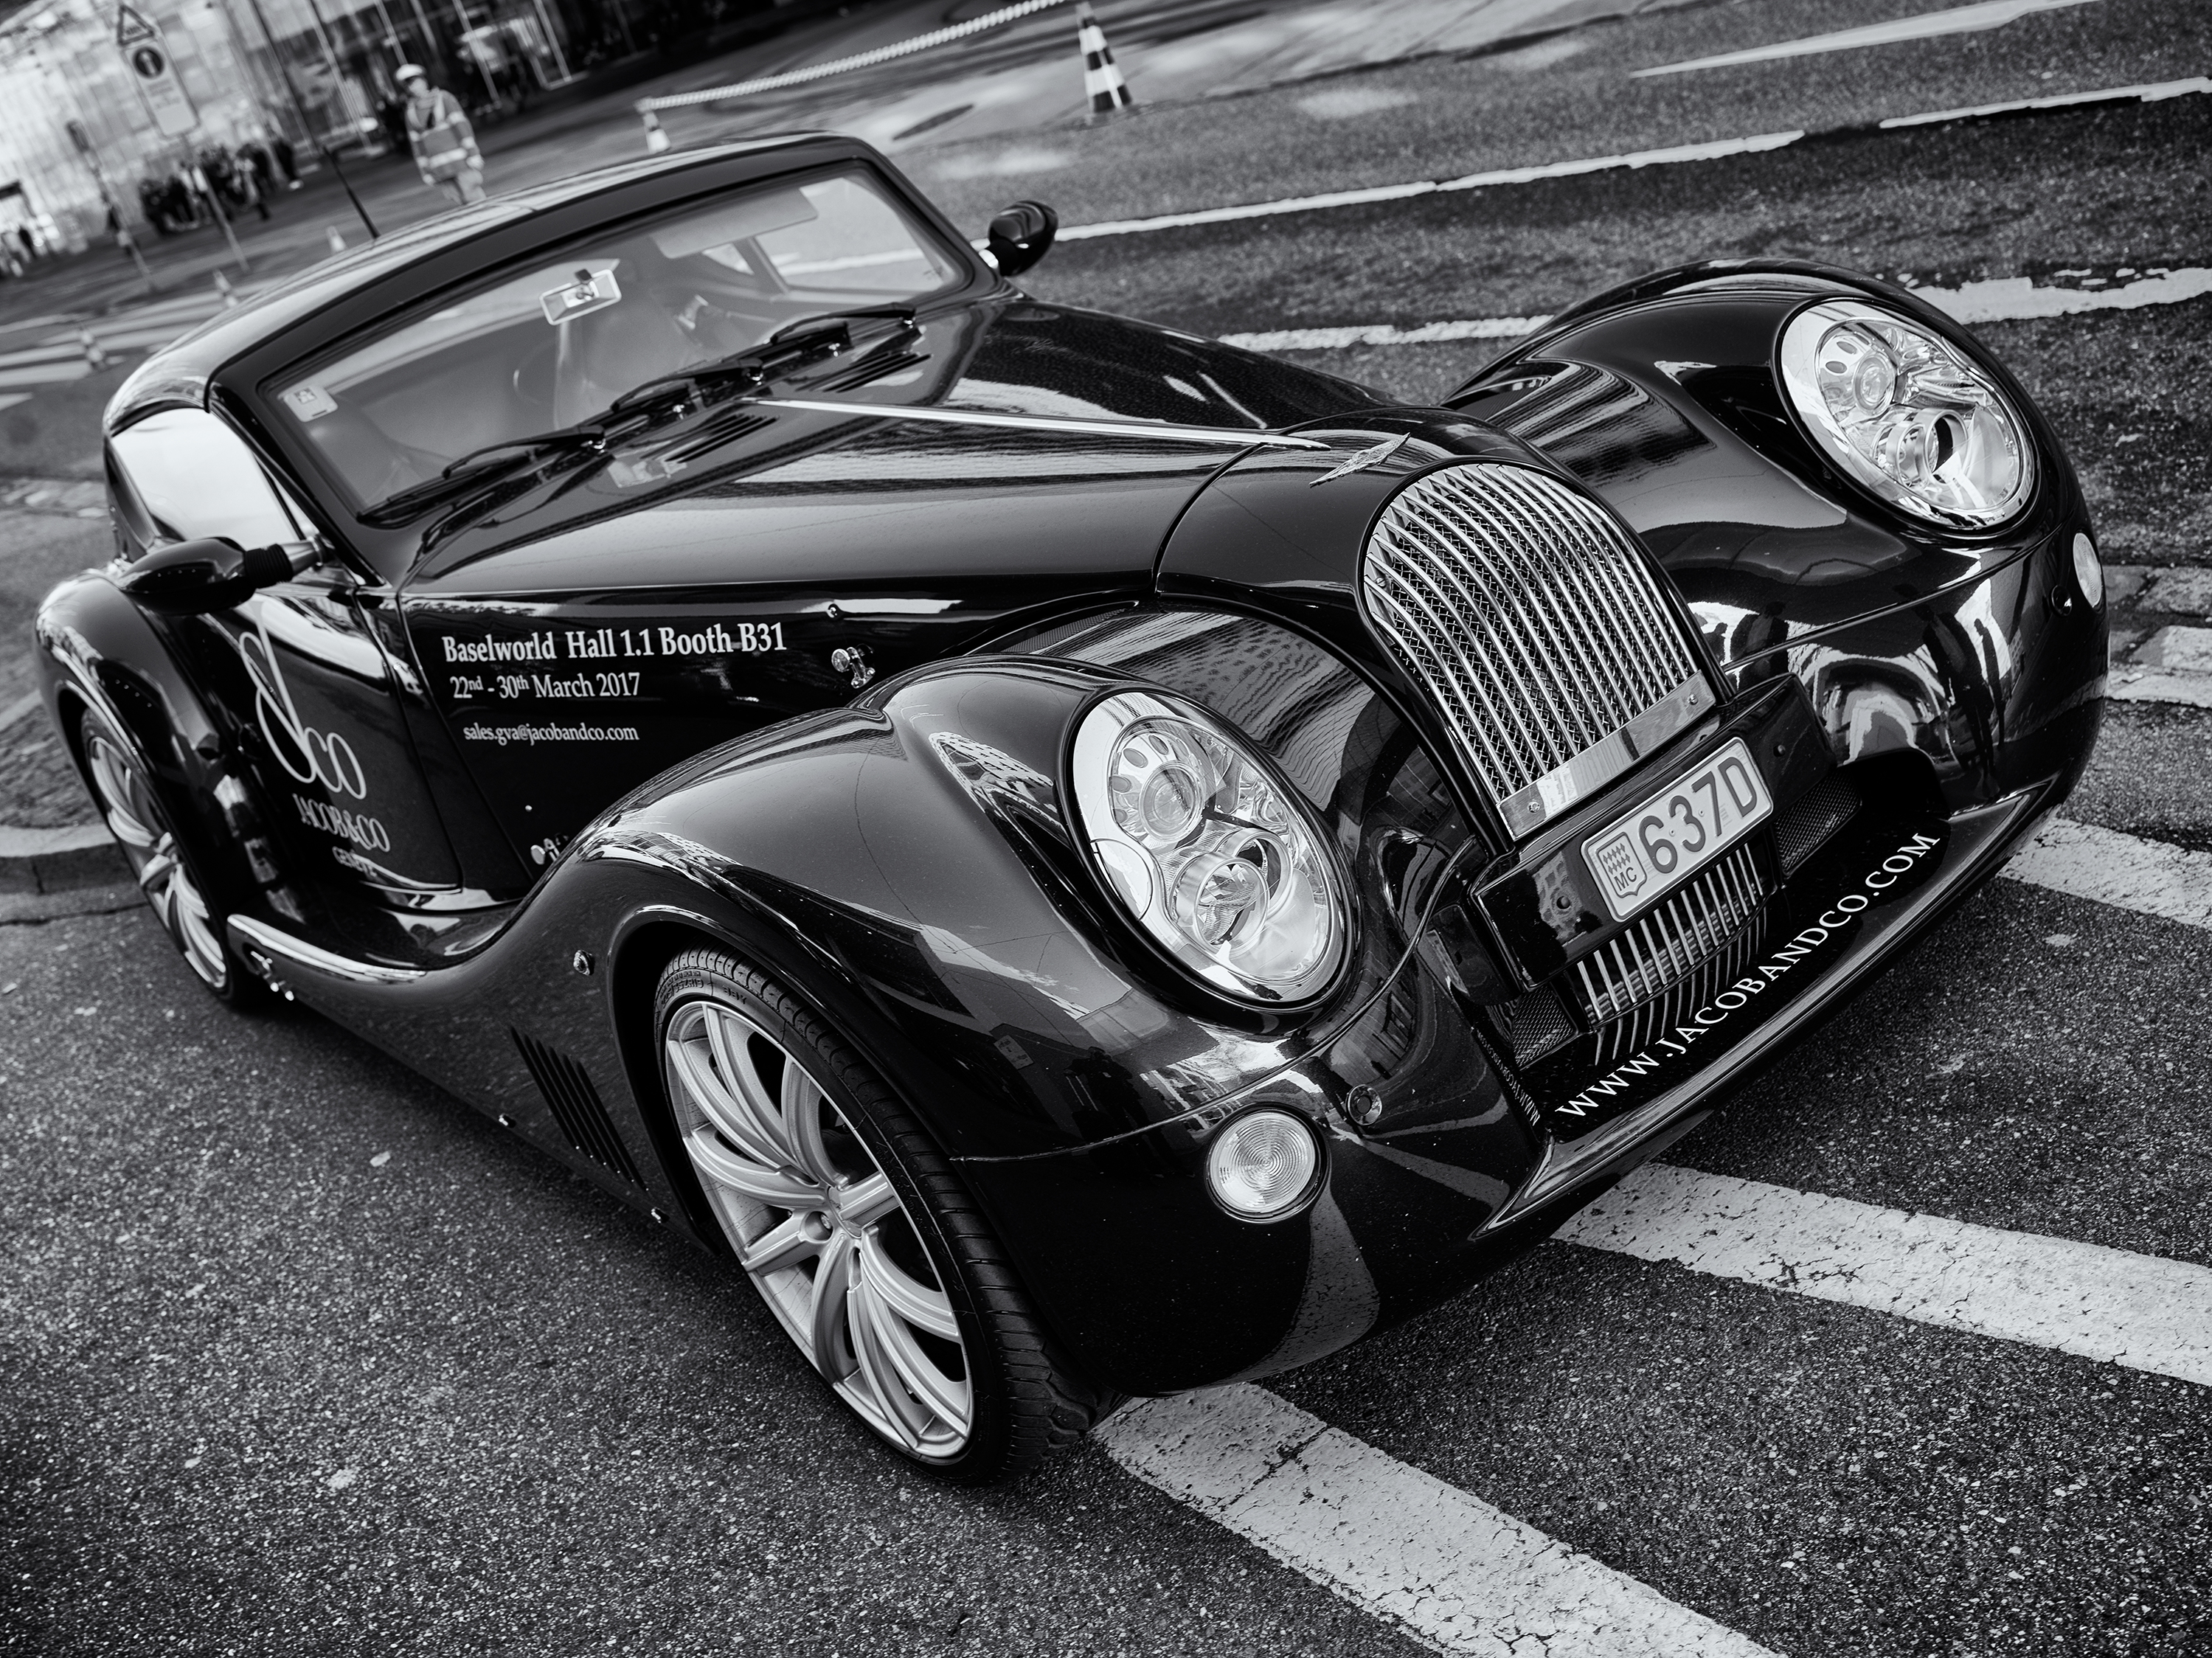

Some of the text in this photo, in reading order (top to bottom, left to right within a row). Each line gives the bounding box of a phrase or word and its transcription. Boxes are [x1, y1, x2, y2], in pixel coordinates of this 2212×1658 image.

[441, 622, 787, 662] Baselworld Hall 1.1 Booth B31
[449, 675, 484, 698] 22nd
[496, 674, 530, 698] 30th
[531, 672, 595, 698] March
[596, 672, 640, 696] 2017
[463, 722, 639, 746] sales.gva@jacobandco.com
[1638, 756, 1758, 874] 637D
[1613, 867, 1637, 892] MC
[1555, 833, 1941, 1117] WWW.JACOBANDCO.COM
